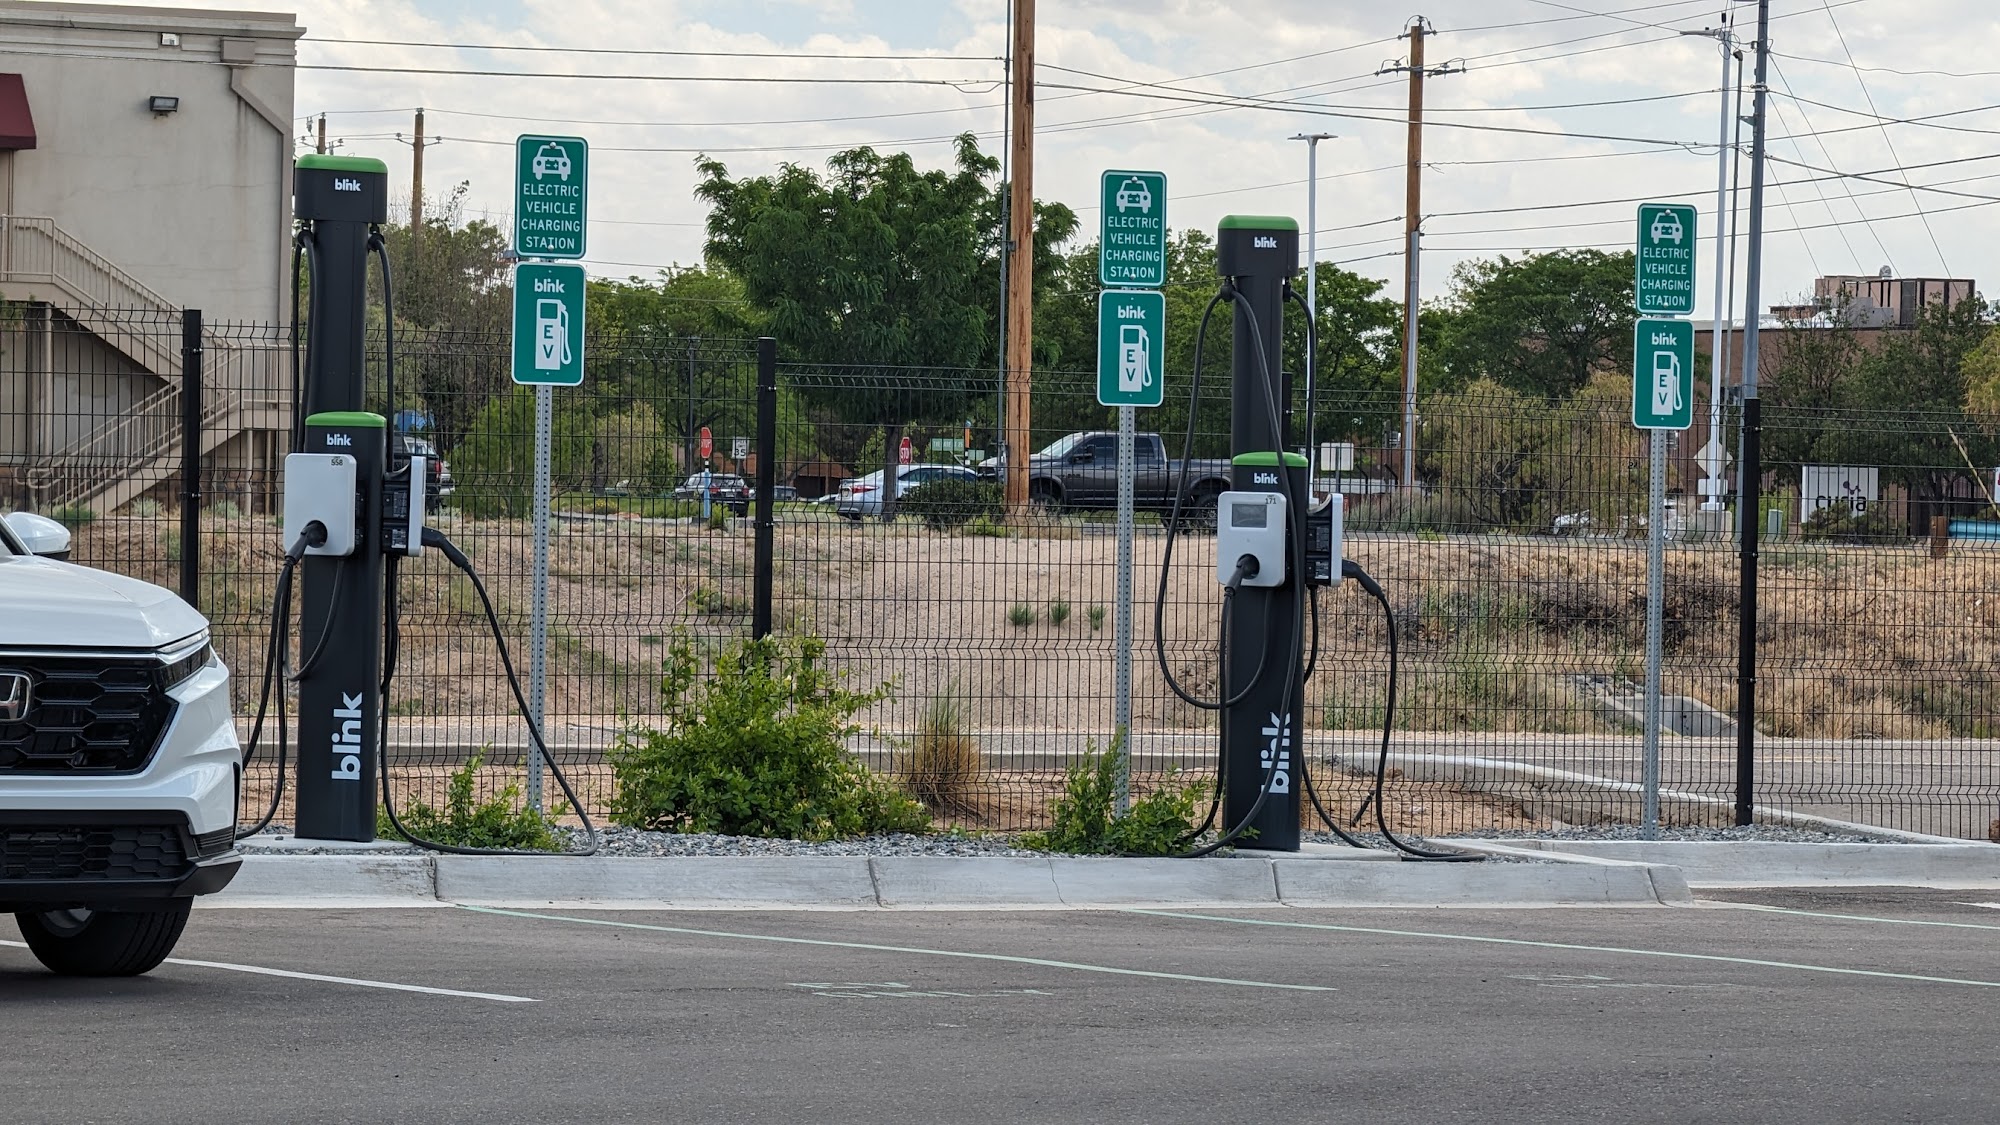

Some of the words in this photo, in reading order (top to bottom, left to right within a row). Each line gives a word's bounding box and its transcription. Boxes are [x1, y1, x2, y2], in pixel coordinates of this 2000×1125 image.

[335, 178, 361, 191] blink
[523, 184, 579, 197] ELECTRIC
[526, 201, 576, 215] VEHICLE
[521, 218, 580, 232] CHARGING
[1108, 216, 1159, 228] ELECTRIC
[526, 236, 575, 249] STATION
[1111, 233, 1156, 245] VEHICLE
[1254, 236, 1277, 248] blink
[1106, 250, 1160, 262] CHARGING
[1643, 247, 1689, 258] ELECTRIC
[1111, 266, 1155, 278] STATION
[1646, 263, 1687, 275] VEHICLE
[534, 279, 565, 293] blink
[1641, 279, 1690, 290] CHARGING
[1645, 295, 1685, 306] STATION
[1117, 305, 1146, 319] blink
[1652, 333, 1677, 345] blink
[326, 433, 352, 446] blink
[1253, 472, 1278, 484] blink
[1265, 497, 1277, 505] 171
[331, 692, 363, 780] blink
[1260, 711, 1291, 794] blink
